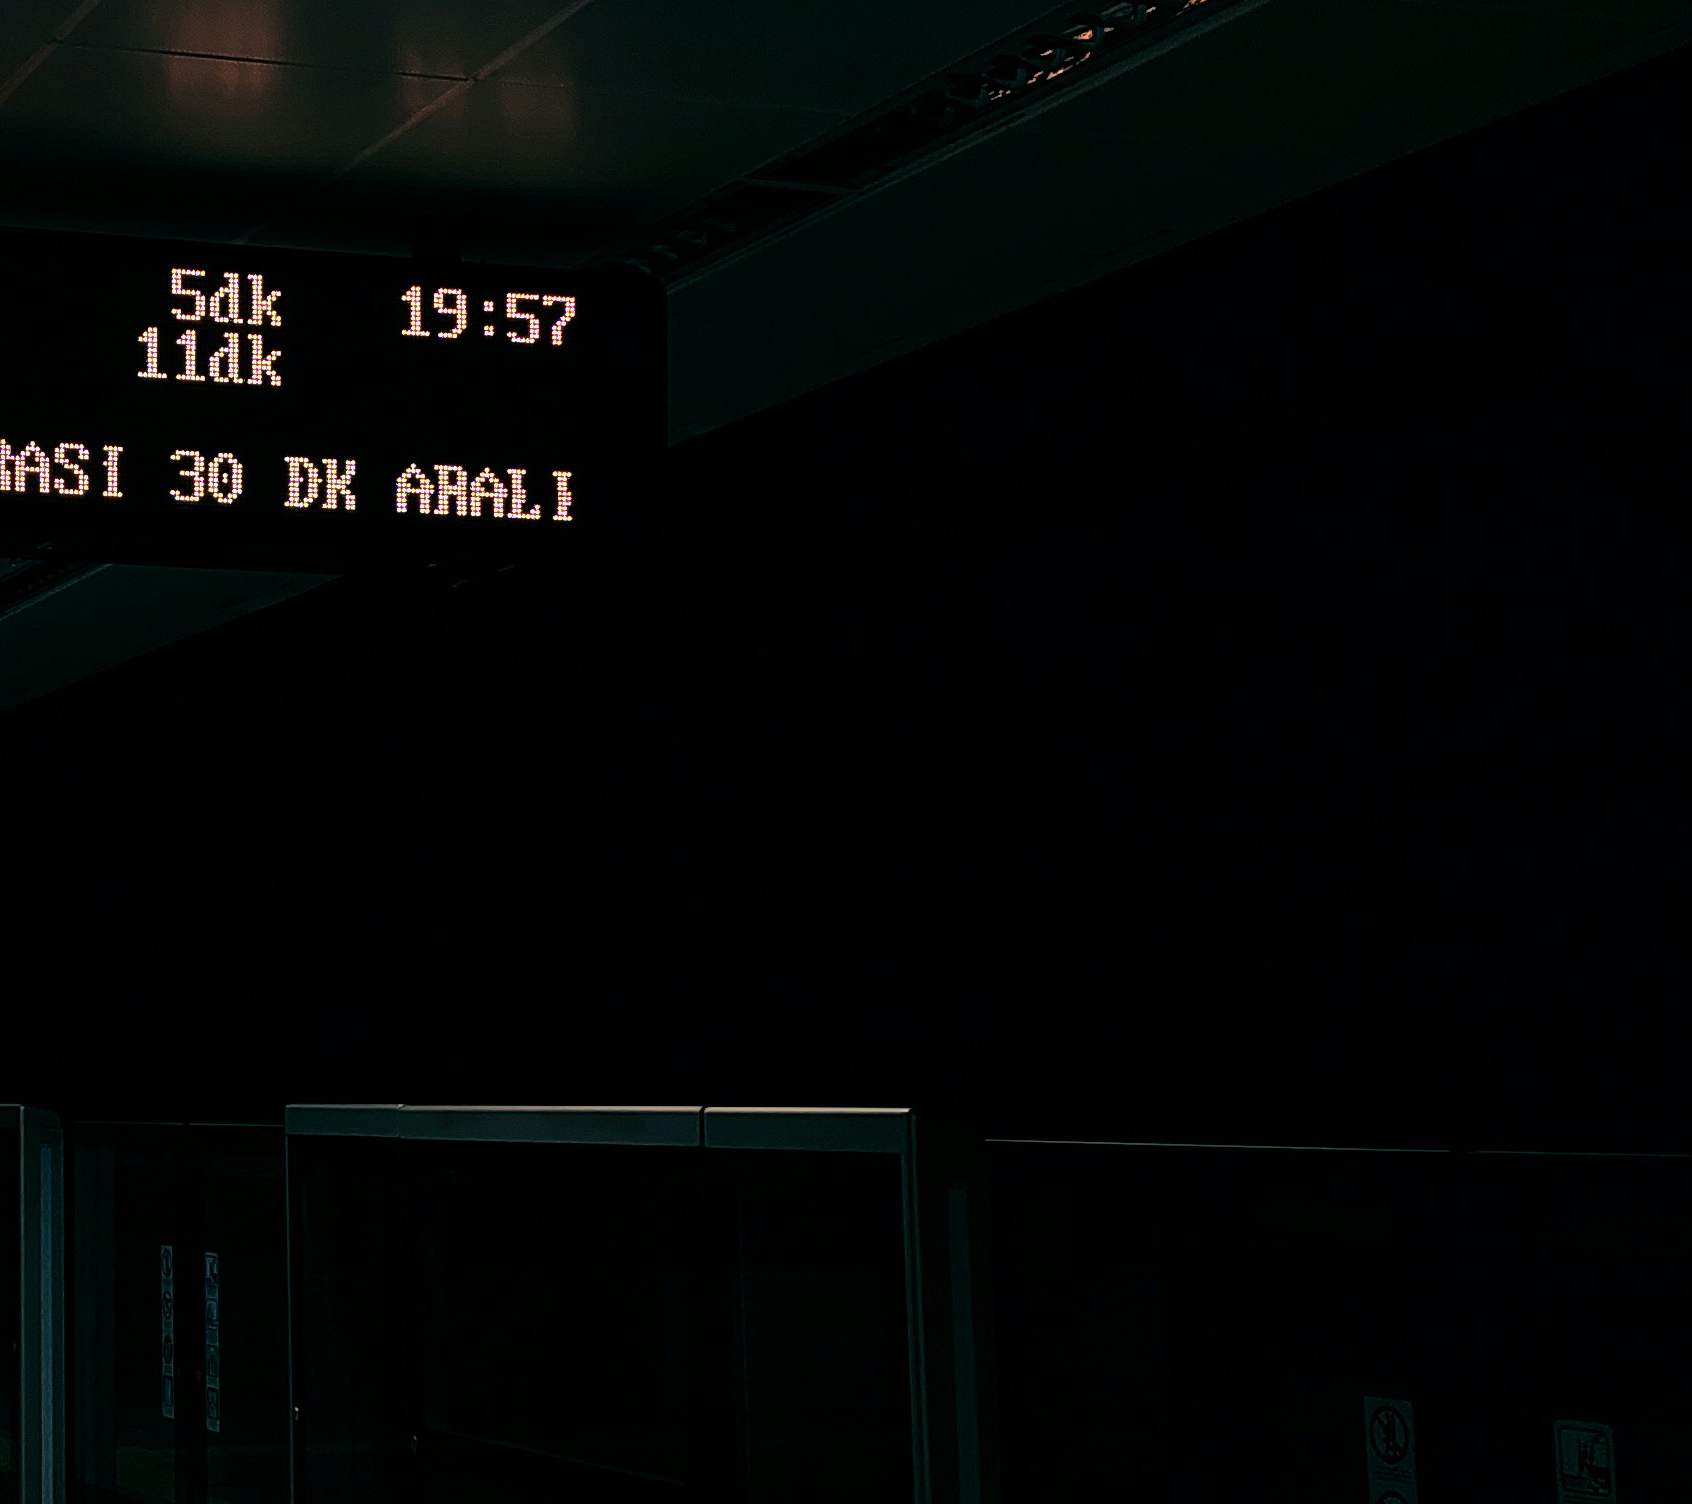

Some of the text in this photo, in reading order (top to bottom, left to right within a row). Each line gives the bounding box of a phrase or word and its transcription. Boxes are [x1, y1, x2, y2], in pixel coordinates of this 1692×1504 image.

[170, 267, 283, 328] 5dk
[401, 285, 578, 347] 19:57
[137, 325, 283, 388] 11dk
[169, 449, 244, 505] 30
[283, 456, 357, 512] DK
[395, 462, 574, 523] ARALI
